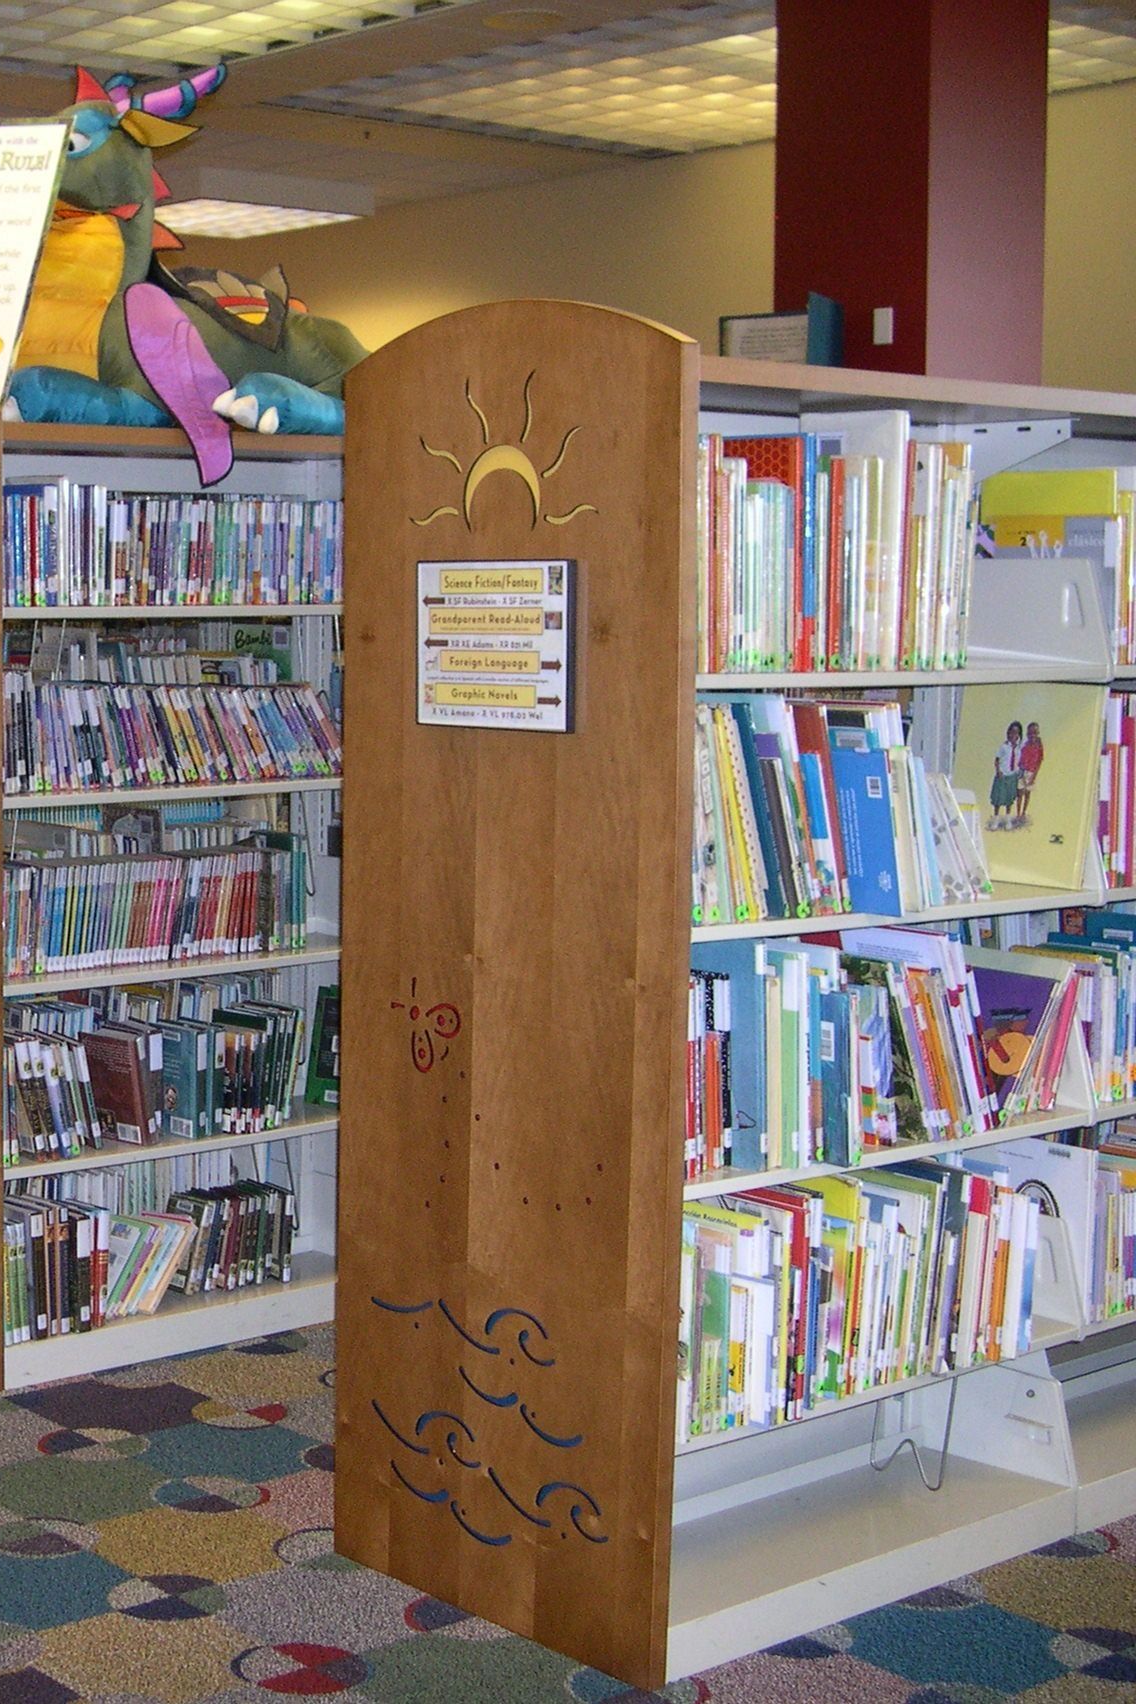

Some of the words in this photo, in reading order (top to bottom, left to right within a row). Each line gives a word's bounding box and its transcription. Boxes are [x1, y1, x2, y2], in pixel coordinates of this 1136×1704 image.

[6, 137, 24, 145] with
[27, 136, 38, 144] the
[5, 184, 20, 193] the
[23, 184, 41, 193] first
[7, 217, 32, 226] word
[444, 576, 472, 588] Science
[475, 574, 538, 590] Fiction/Fantasy
[453, 597, 461, 605] SF
[509, 597, 518, 605] SF
[432, 614, 486, 625] Grandparent
[489, 614, 541, 624] Read-Aloud
[235, 629, 273, 649] Bambi
[449, 656, 483, 670] Foreign
[485, 657, 528, 670] Language
[451, 688, 485, 700] Graphic
[488, 690, 519, 701] Novels
